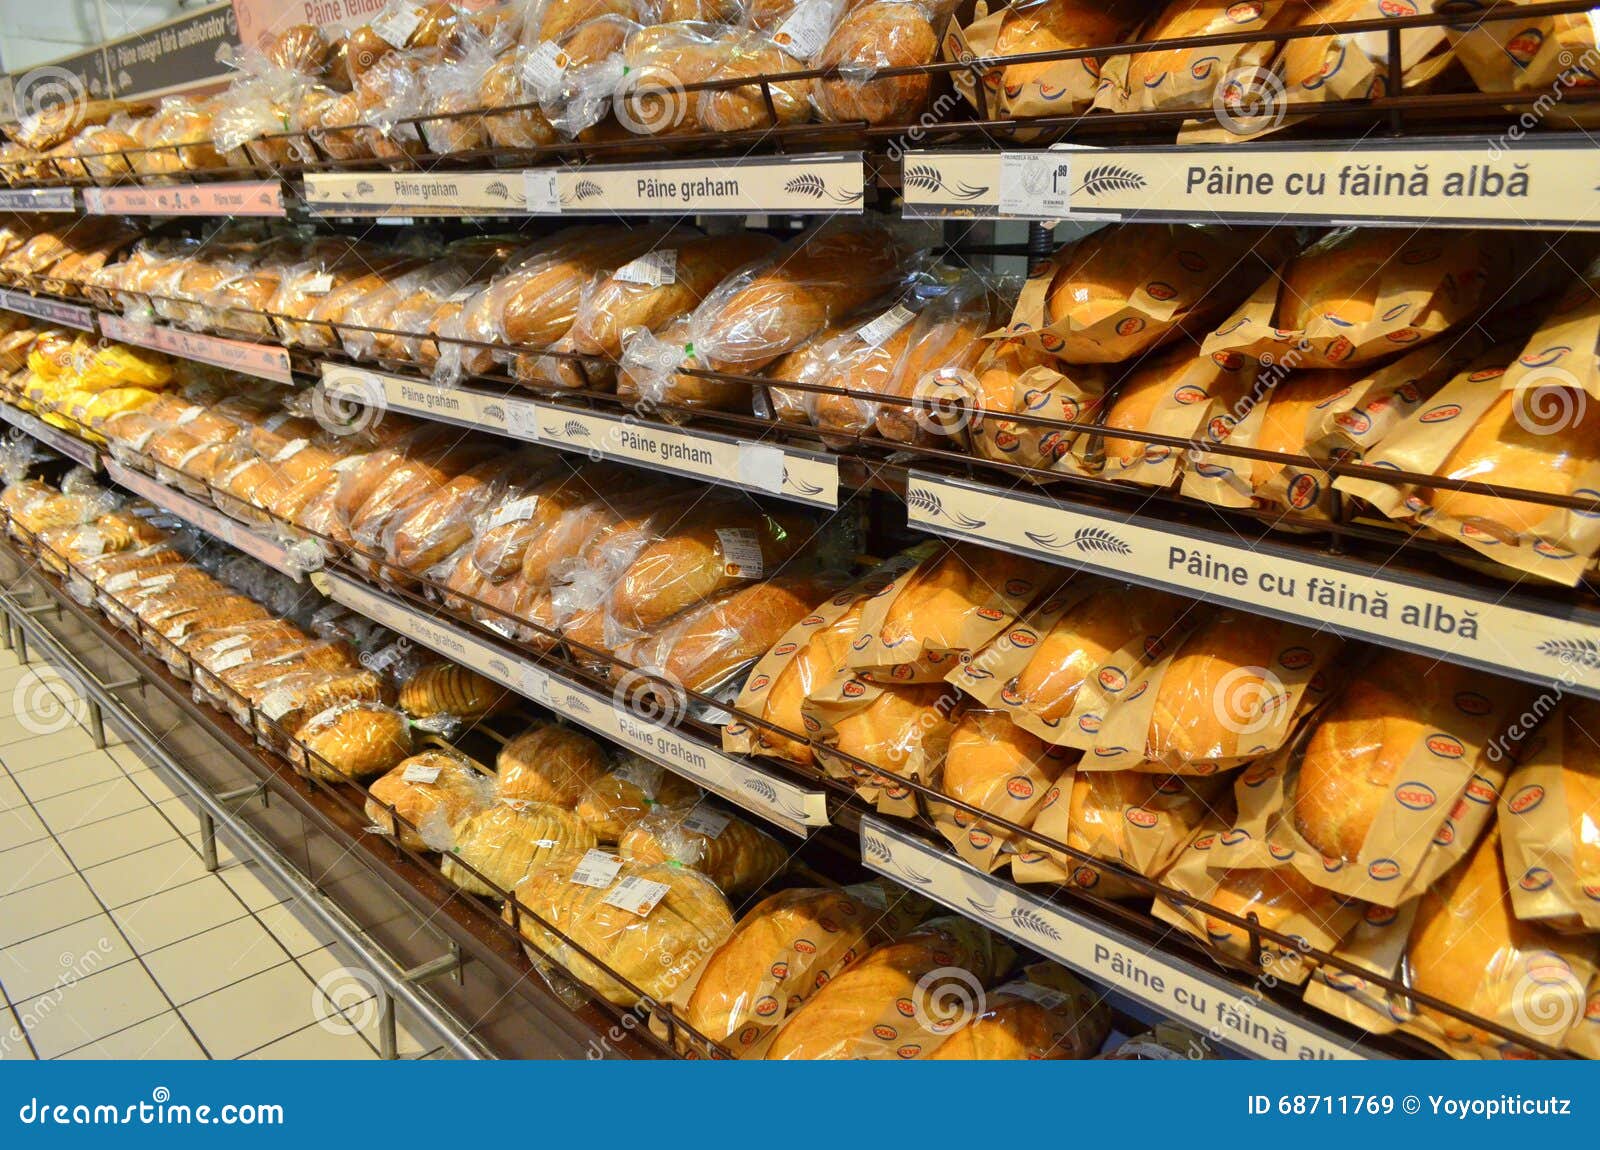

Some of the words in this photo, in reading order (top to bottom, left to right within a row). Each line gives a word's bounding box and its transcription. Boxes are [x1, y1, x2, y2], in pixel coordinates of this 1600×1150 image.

[1382, 2, 1417, 16] cora
[1186, 165, 1274, 196] Pâine
[1285, 172, 1326, 196] cu
[1338, 163, 1430, 197] făină
[1442, 163, 1532, 197] albă
[395, 180, 420, 197] Pâine
[421, 181, 459, 200] graham
[637, 177, 677, 198] Pâine
[681, 177, 739, 201] graham
[401, 386, 425, 403] Pâine
[426, 394, 460, 411] graham
[1421, 408, 1459, 422] cora
[620, 430, 657, 454] Pâine
[660, 441, 713, 466] graham
[1168, 546, 1249, 586] Pâine
[1258, 572, 1296, 597] cu
[1307, 577, 1389, 620] făină
[1400, 602, 1479, 641] albă
[978, 607, 1003, 618] cora
[1011, 633, 1036, 645] cora
[619, 718, 654, 745] Pâine
[656, 737, 707, 769] graham
[1427, 741, 1463, 753] cora
[1008, 783, 1032, 795] cora
[1396, 790, 1435, 803] cora
[1510, 787, 1544, 811] cora
[1127, 811, 1156, 824] cora
[795, 943, 816, 953] cora
[1093, 943, 1166, 993] Pâine
[1173, 986, 1207, 1015] cu
[1215, 1001, 1289, 1053] făină
[757, 1002, 778, 1013] cora
[873, 1028, 896, 1037] cora
